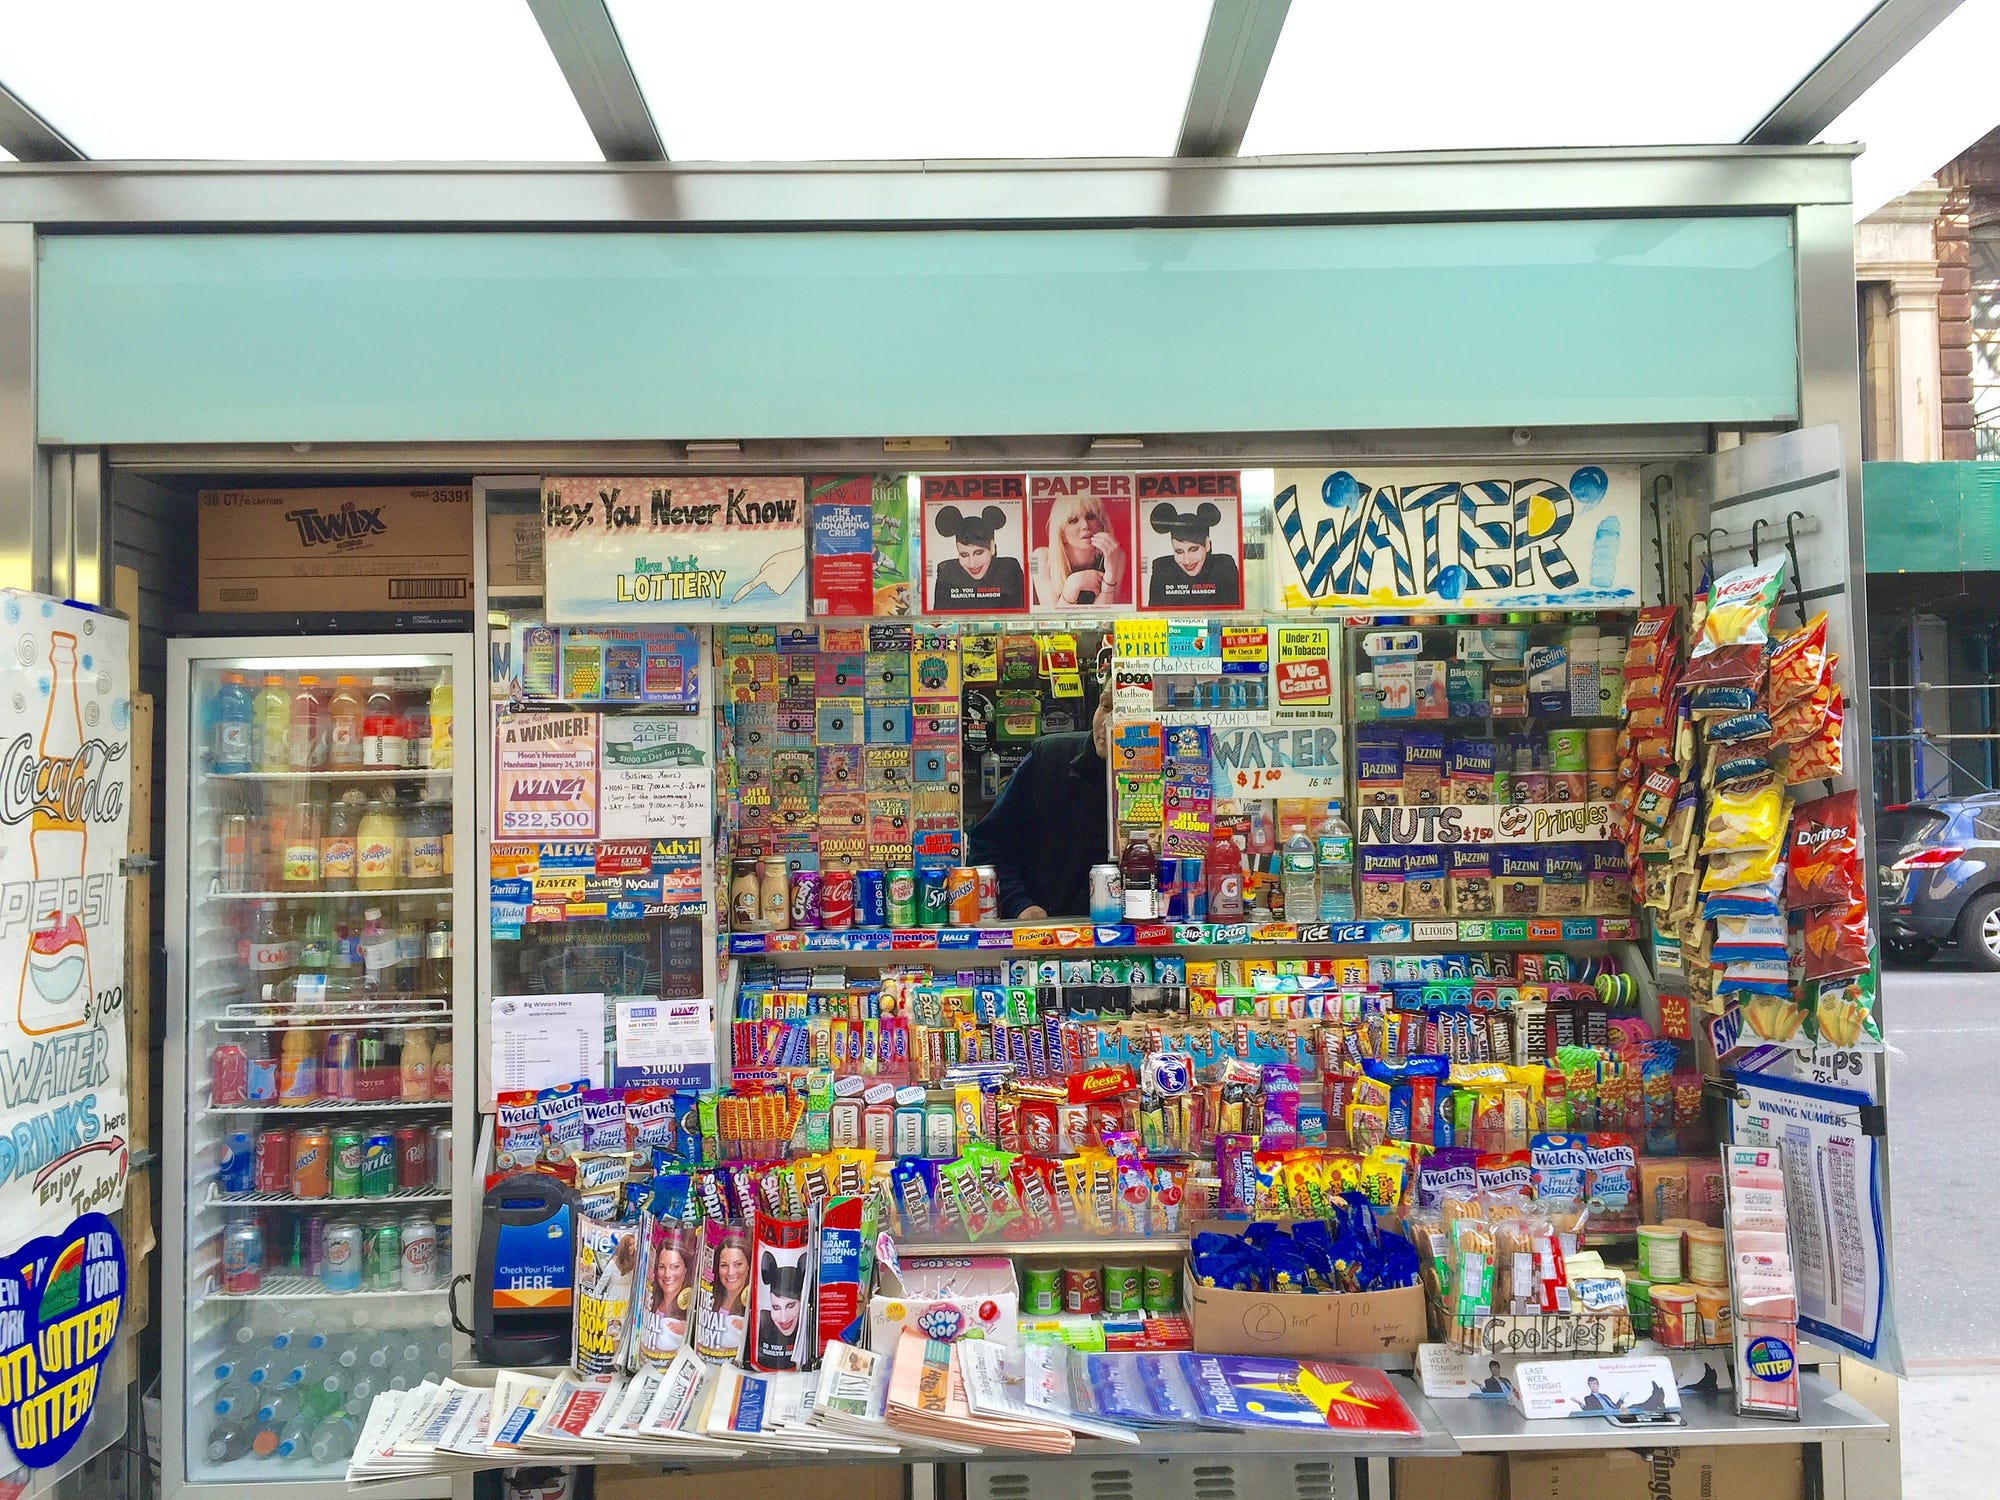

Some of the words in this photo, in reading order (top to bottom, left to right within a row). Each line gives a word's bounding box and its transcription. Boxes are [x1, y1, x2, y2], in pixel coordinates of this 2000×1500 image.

[924, 478, 1023, 499] PAPER
[1032, 475, 1131, 496] PAPER
[1139, 475, 1237, 496] PAPER
[547, 490, 594, 531] Hey,
[599, 488, 641, 529] You
[651, 489, 721, 526] Never
[725, 488, 802, 526] Know.
[833, 507, 850, 515] THE
[815, 522, 870, 530] KIDNAPPING
[821, 515, 863, 523] MIGRANT
[828, 529, 857, 537] CRISIS
[1274, 478, 1579, 598] WATER
[634, 557, 663, 574] New
[667, 555, 699, 573] York
[616, 571, 726, 602] LOTTERY
[1116, 632, 1167, 640] AMERICAN
[1168, 626, 1182, 634] Box
[1237, 636, 1248, 644] the
[1285, 633, 1310, 643] Under
[1312, 633, 1322, 643] 21
[1116, 642, 1167, 656] SPIRIT
[1282, 646, 1293, 656] No
[1294, 645, 1326, 656] Tobacco
[1528, 646, 1567, 671] Vaseline
[1286, 663, 1319, 679] We
[1450, 668, 1480, 678] Blistex
[1279, 676, 1328, 694] Card
[1722, 687, 1744, 695] TWISTS
[1116, 688, 1150, 699] Marlboro
[1276, 710, 1294, 718] Please
[1317, 711, 1333, 719] Ready
[505, 729, 517, 743] A
[519, 716, 589, 742] WINNER!
[632, 722, 679, 732] CASH
[632, 732, 678, 743] 4LIFE
[677, 747, 692, 757] Life
[868, 750, 908, 760] $2,500
[1211, 728, 1339, 770] WATER
[1405, 745, 1442, 762] BAZZINI
[1455, 752, 1491, 769] BAZZINI
[1308, 777, 1319, 787] 16
[504, 812, 589, 829] $22,500
[1359, 807, 1463, 843] NUTS
[1534, 803, 1608, 842] Pringles
[1796, 825, 1849, 846] Doritos
[491, 846, 530, 856] Motrin
[540, 843, 594, 857] ALEVE
[600, 844, 649, 856] TYLENOL
[652, 840, 700, 855] Advil
[361, 848, 392, 862] Snapple
[1453, 851, 1490, 867] BAZZINI
[535, 878, 577, 888] BAYER
[625, 879, 659, 890] NyQuil
[1, 873, 113, 937] PEPSI
[875, 880, 884, 916] pepsi
[610, 909, 640, 919] Seltzer
[643, 904, 679, 914] Zantac
[847, 932, 891, 942] mentos
[893, 932, 937, 942] mentos
[1175, 929, 1210, 939] eclipse
[1216, 926, 1246, 942] Extra
[1302, 927, 1330, 941] ICE
[1337, 927, 1365, 942] ICE
[1418, 926, 1454, 936] ALTOIDS
[1749, 926, 1783, 935] ORIGINAL
[941, 933, 970, 943] HALLS
[1047, 1018, 1064, 1073] SNICKERS
[0, 1026, 109, 1109] WATER
[641, 1064, 685, 1076] $1000
[733, 1069, 778, 1080] mentos
[624, 1079, 631, 1087] A
[632, 1078, 660, 1087] WEEK
[661, 1078, 680, 1086] FOR
[682, 1076, 702, 1085] LIFE
[1813, 1069, 1833, 1085] 75¢
[1759, 1100, 1798, 1118] WINNING
[1800, 1109, 1848, 1128] NUMBERS
[0, 1093, 100, 1189] DRINKS
[104, 1112, 126, 1133] here
[1535, 1151, 1585, 1167] Welch's
[1586, 1148, 1633, 1166] Welch's
[580, 1159, 626, 1177] Famous
[71, 1148, 128, 1217] Today!
[593, 1169, 627, 1188] Amos
[1423, 1169, 1474, 1187] Welch's
[1549, 1176, 1574, 1186] Fruit
[1601, 1174, 1624, 1185] Fruit
[40, 1164, 83, 1207] Enjoy
[1541, 1184, 1579, 1195] Snacks
[1594, 1182, 1629, 1193] Snacks
[826, 1232, 839, 1240] THE
[86, 1231, 113, 1262] NEW
[500, 1266, 523, 1274] Check
[542, 1265, 565, 1273] Ticket
[85, 1260, 119, 1303] YORK
[511, 1275, 553, 1289] HERE
[918, 1310, 960, 1329] BLOW
[38, 1294, 121, 1373] LOTTERY
[928, 1323, 957, 1338] POP
[1482, 1317, 1606, 1351] Cookies
[1767, 1337, 1786, 1349] NEW
[1430, 1364, 1464, 1372] TONIGHT
[1524, 1367, 1544, 1375] LAST
[1752, 1360, 1793, 1378] LOTTERY
[1527, 1382, 1562, 1391] TONIGHT
[12, 1362, 99, 1450] LOTTERY
